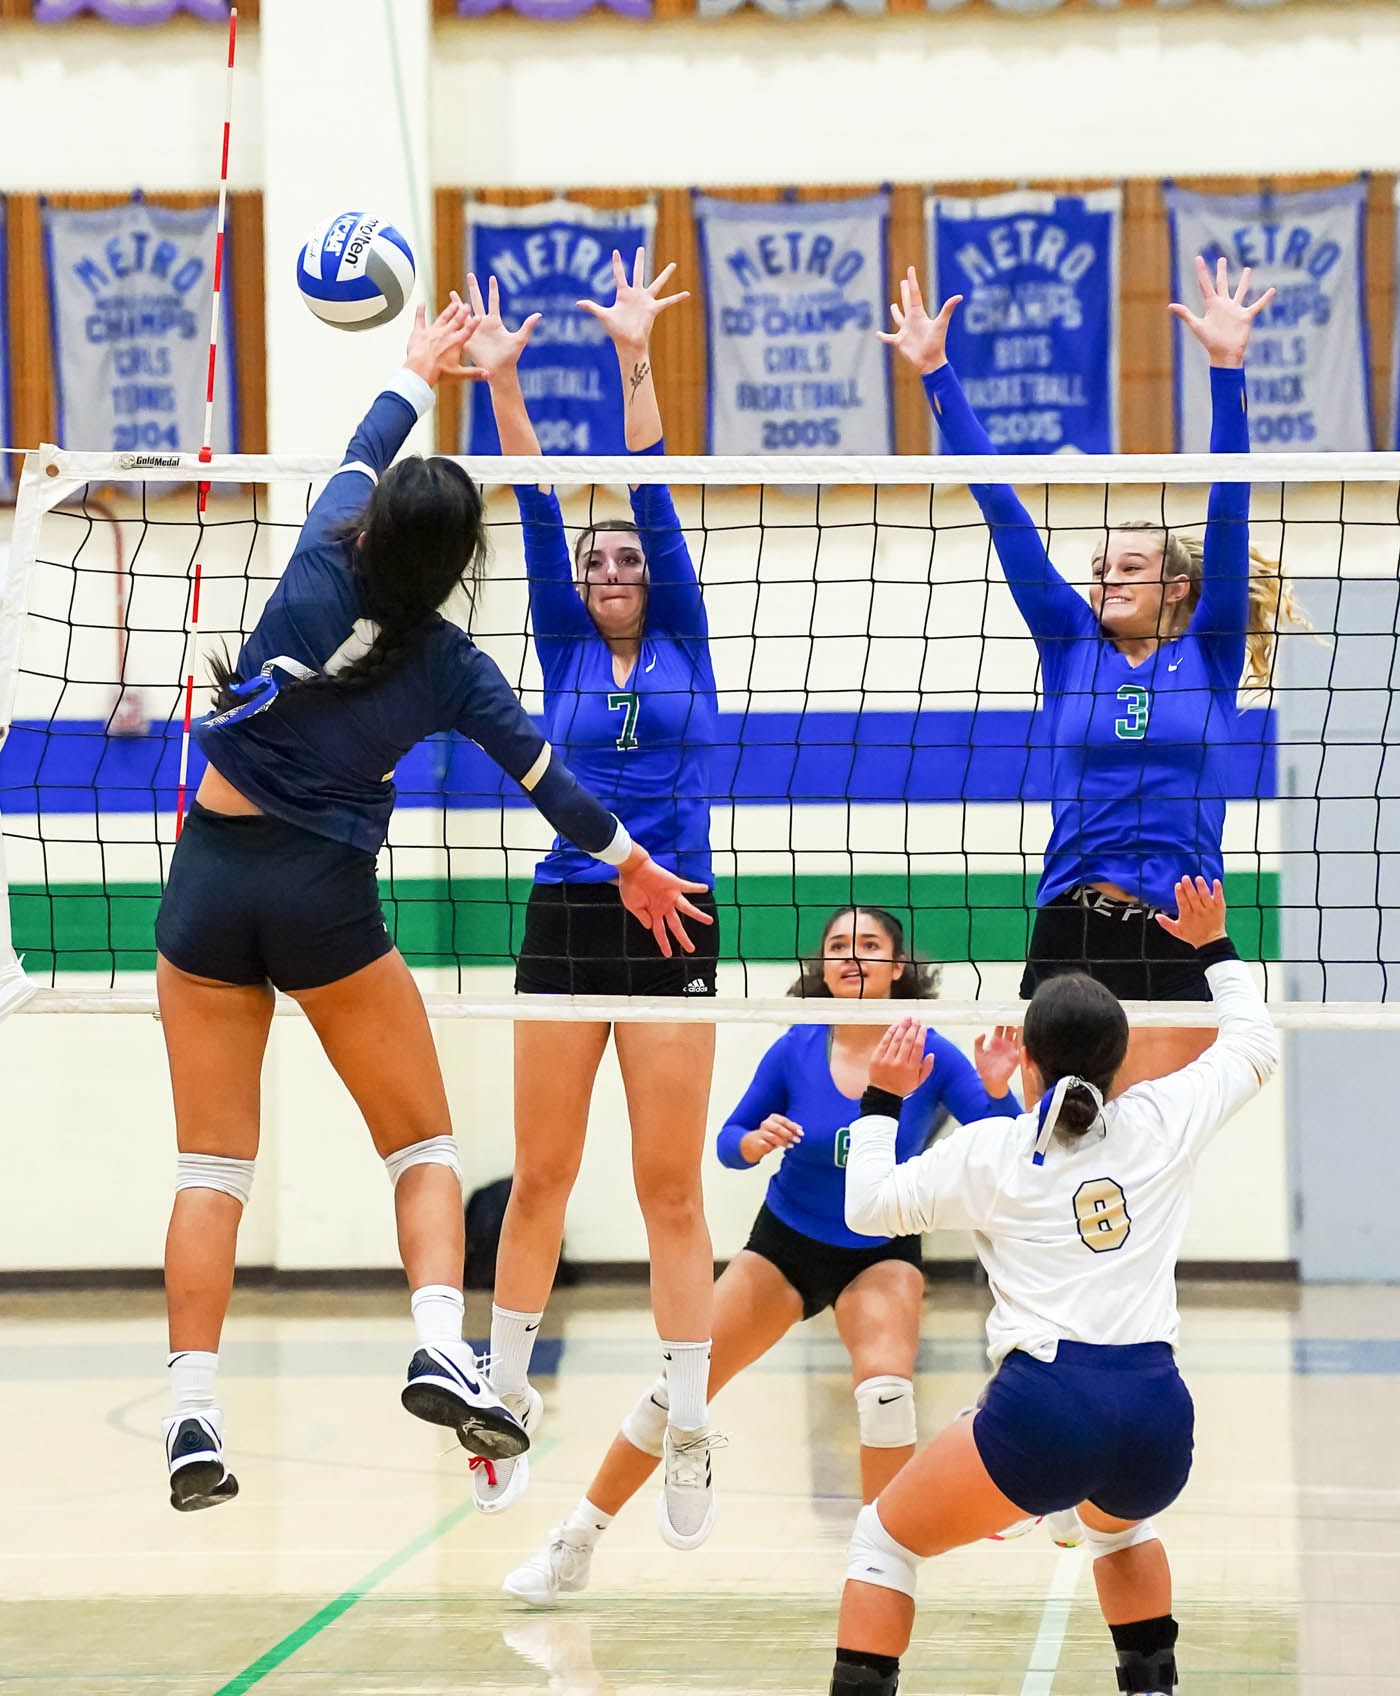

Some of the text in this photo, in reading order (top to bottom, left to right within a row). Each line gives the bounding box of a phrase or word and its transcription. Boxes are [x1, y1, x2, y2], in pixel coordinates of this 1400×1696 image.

[73, 230, 205, 294] METRO
[344, 218, 379, 267] molten
[489, 229, 630, 295] METRO
[726, 230, 865, 287] METRO
[956, 219, 1096, 287] METRO
[85, 309, 198, 343] CHAMPS
[720, 300, 873, 337] CO-CHAMPS
[964, 296, 1083, 335] CHAMPS
[763, 343, 831, 374] GIRLS
[736, 377, 863, 411] BASKETBALL
[762, 417, 842, 449] 2005
[1252, 410, 1318, 442] 005
[607, 692, 640, 752] 7
[1115, 684, 1149, 740] 3
[1072, 1176, 1132, 1254] 8
